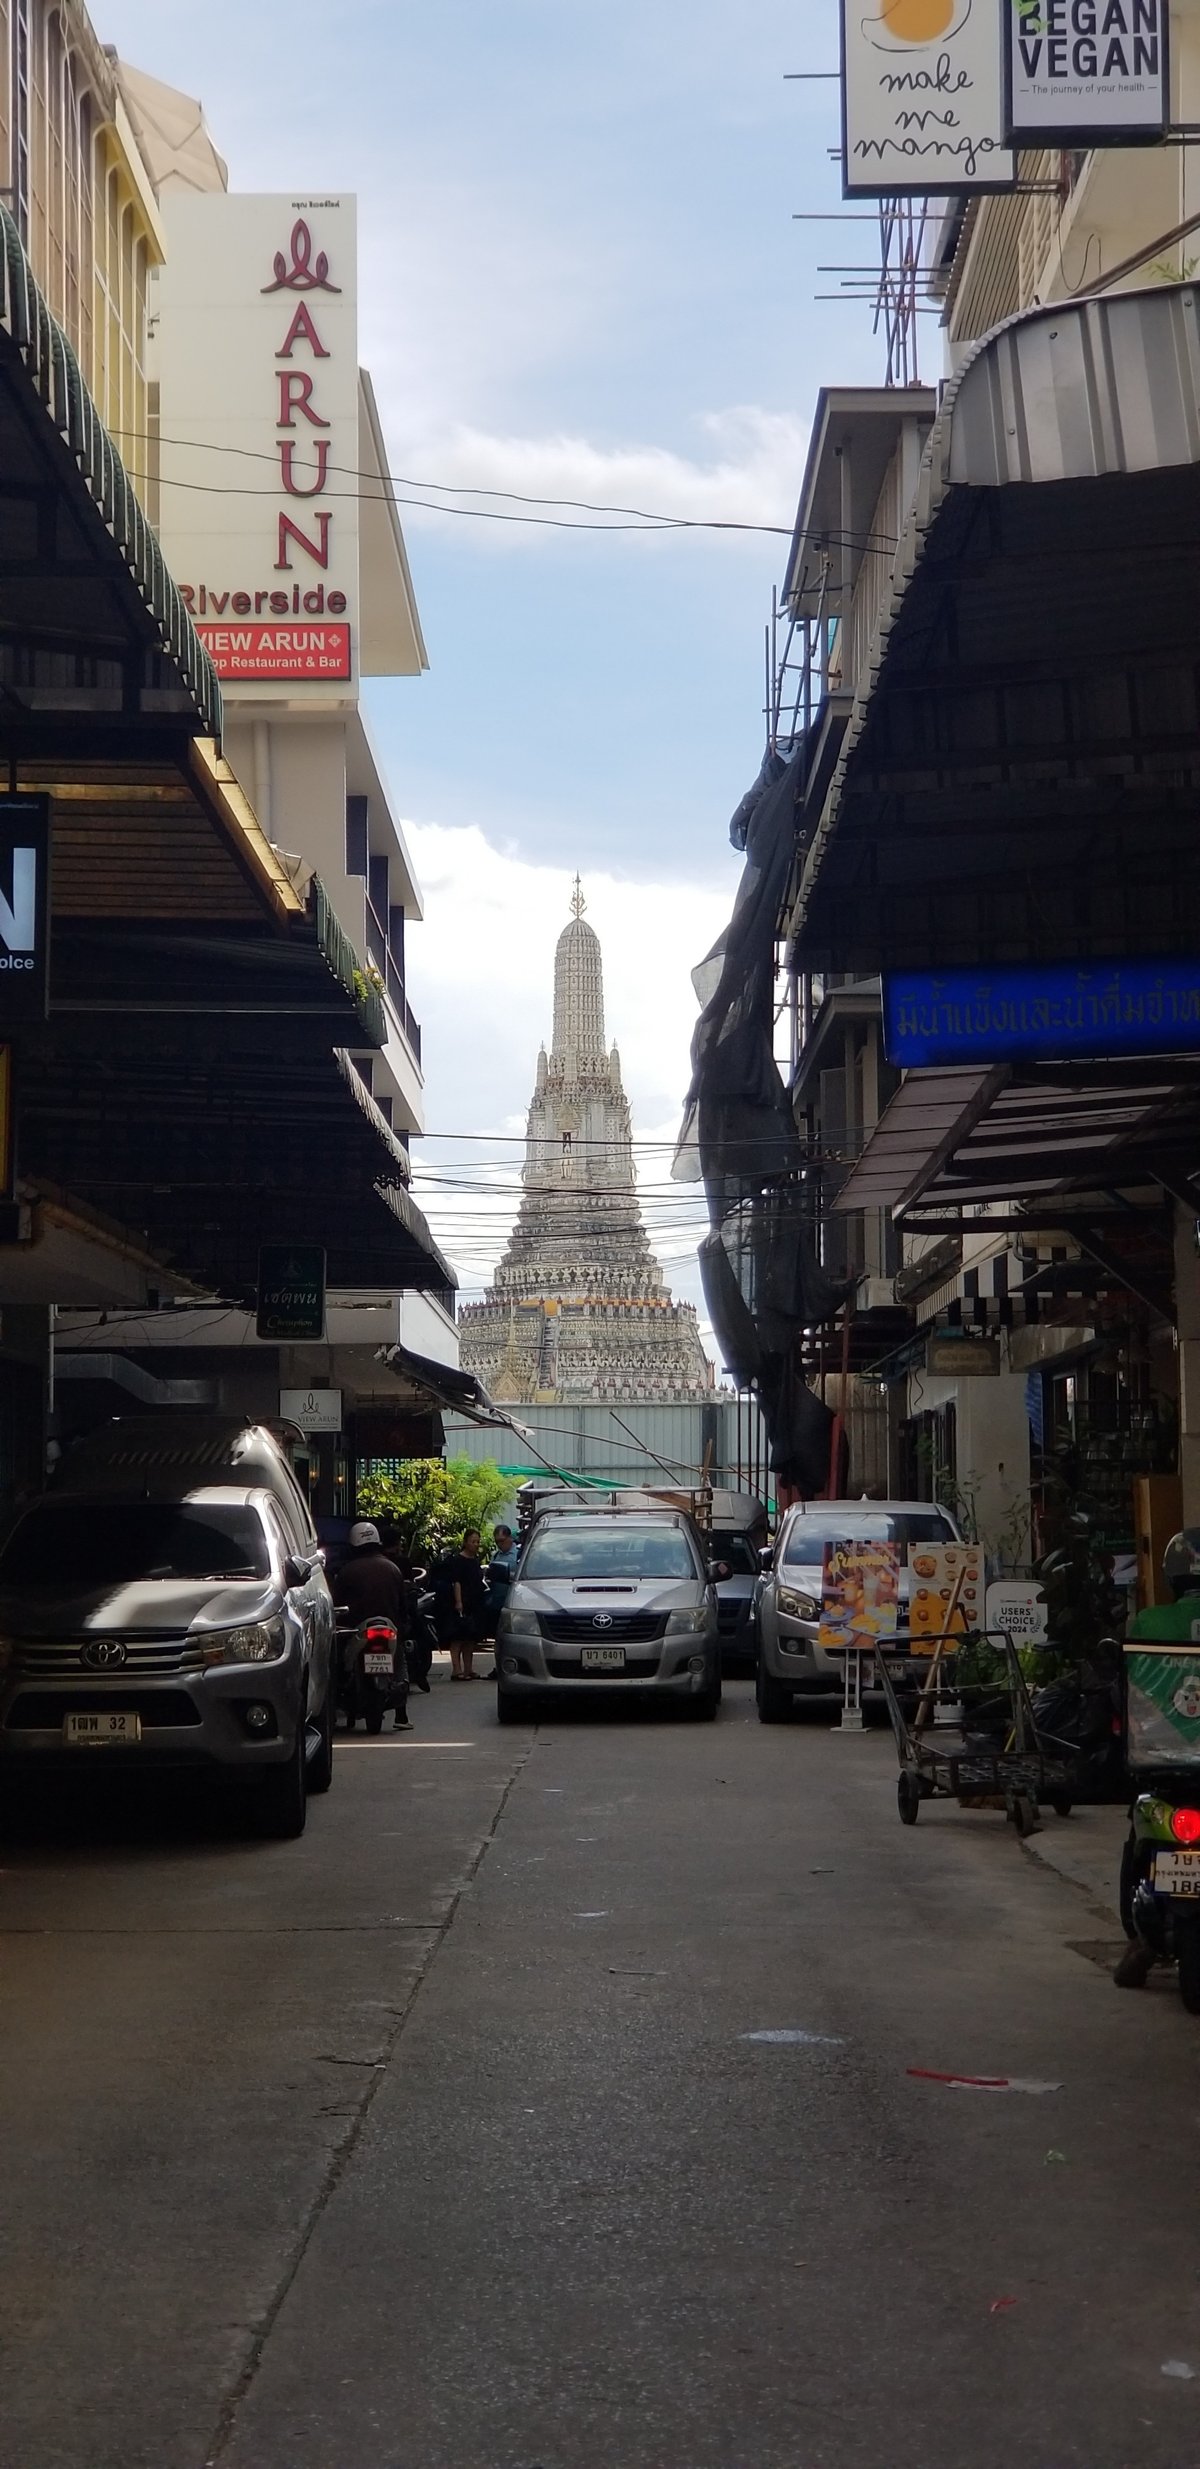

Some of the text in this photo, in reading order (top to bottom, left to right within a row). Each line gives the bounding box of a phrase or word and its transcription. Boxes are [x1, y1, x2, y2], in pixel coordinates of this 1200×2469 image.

[1018, 0, 1158, 36] BEGAN
[1017, 36, 1159, 79] VEGAN
[879, 52, 974, 94] make
[1031, 82, 1146, 96] The journey of your health
[894, 109, 961, 131] me
[853, 136, 1000, 176] mango
[273, 299, 331, 571] ARUN
[177, 583, 348, 616] Riverside
[257, 632, 326, 651] ARUN
[231, 655, 302, 668] Restaurant
[305, 656, 316, 668] &
[318, 656, 343, 668] Bar
[298, 1415, 317, 1423] VIEW
[998, 1616, 1035, 1625] CHOICE
[1001, 1607, 1034, 1616] USERS'
[1007, 1625, 1028, 1634] 2024
[109, 1716, 126, 1731] 32
